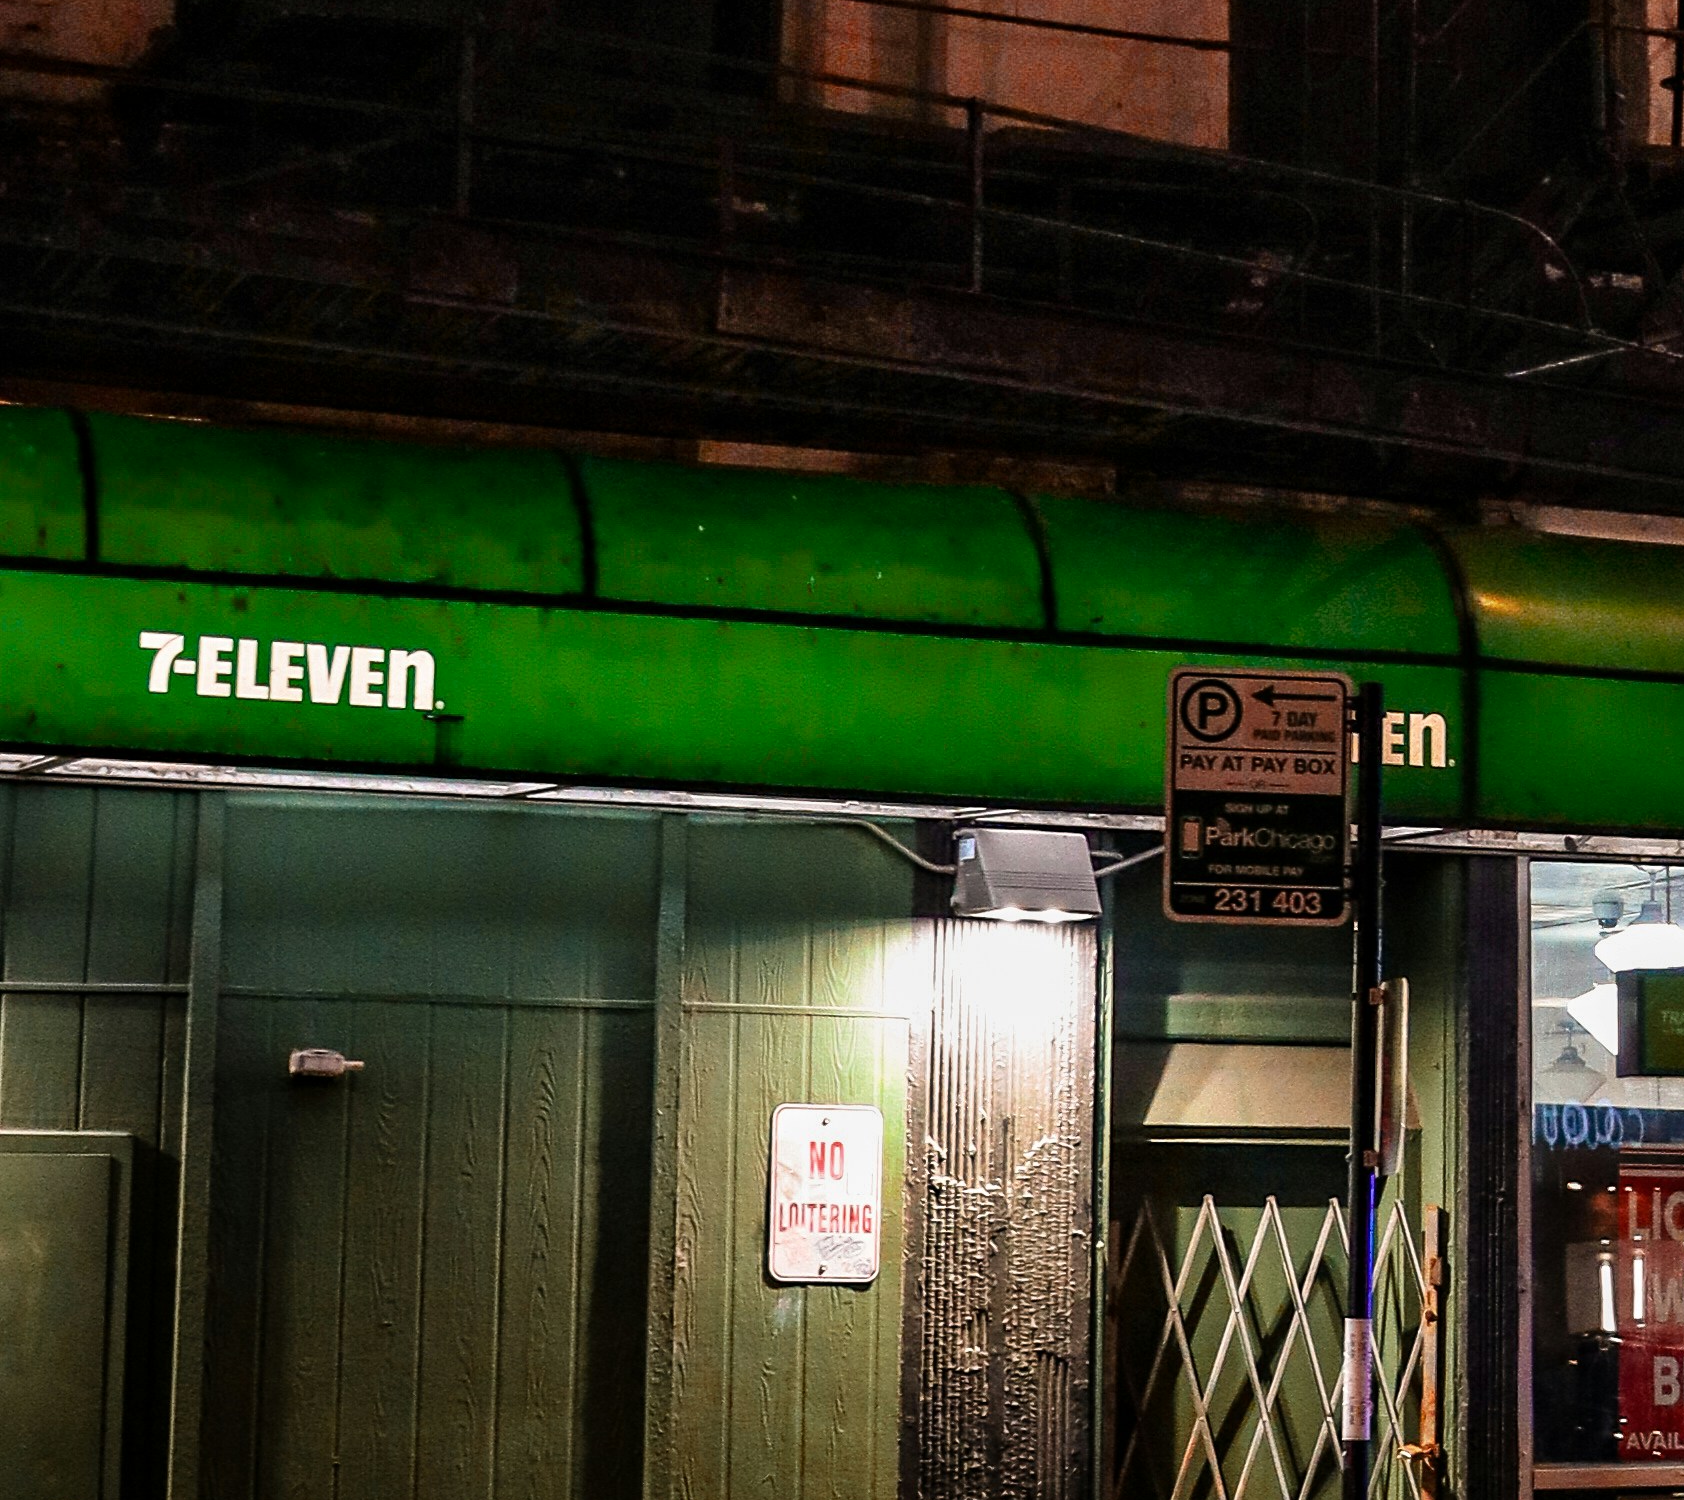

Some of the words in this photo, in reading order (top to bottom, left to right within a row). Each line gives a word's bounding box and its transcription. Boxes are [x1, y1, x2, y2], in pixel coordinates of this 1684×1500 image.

[1198, 691, 1229, 730] P
[1272, 711, 1281, 727] 7
[1286, 711, 1318, 728] DAY
[1252, 729, 1281, 742] PAID
[1283, 730, 1336, 744] PARKING
[1180, 754, 1218, 771] PAY
[1221, 756, 1245, 772] AT
[1251, 757, 1288, 774] PAY
[1294, 759, 1336, 775] BOX
[1225, 803, 1253, 814] SIGN
[1256, 805, 1272, 815] UP
[1275, 805, 1289, 815] AT
[1204, 826, 1336, 854] ParkChicago
[1208, 864, 1232, 875] FOR
[1235, 865, 1280, 877] MOBILE
[1282, 867, 1305, 877] PAY
[1214, 888, 1261, 913] 231
[1272, 891, 1323, 915] 403
[809, 1141, 845, 1181] NO
[779, 1202, 873, 1234] LOITERING
